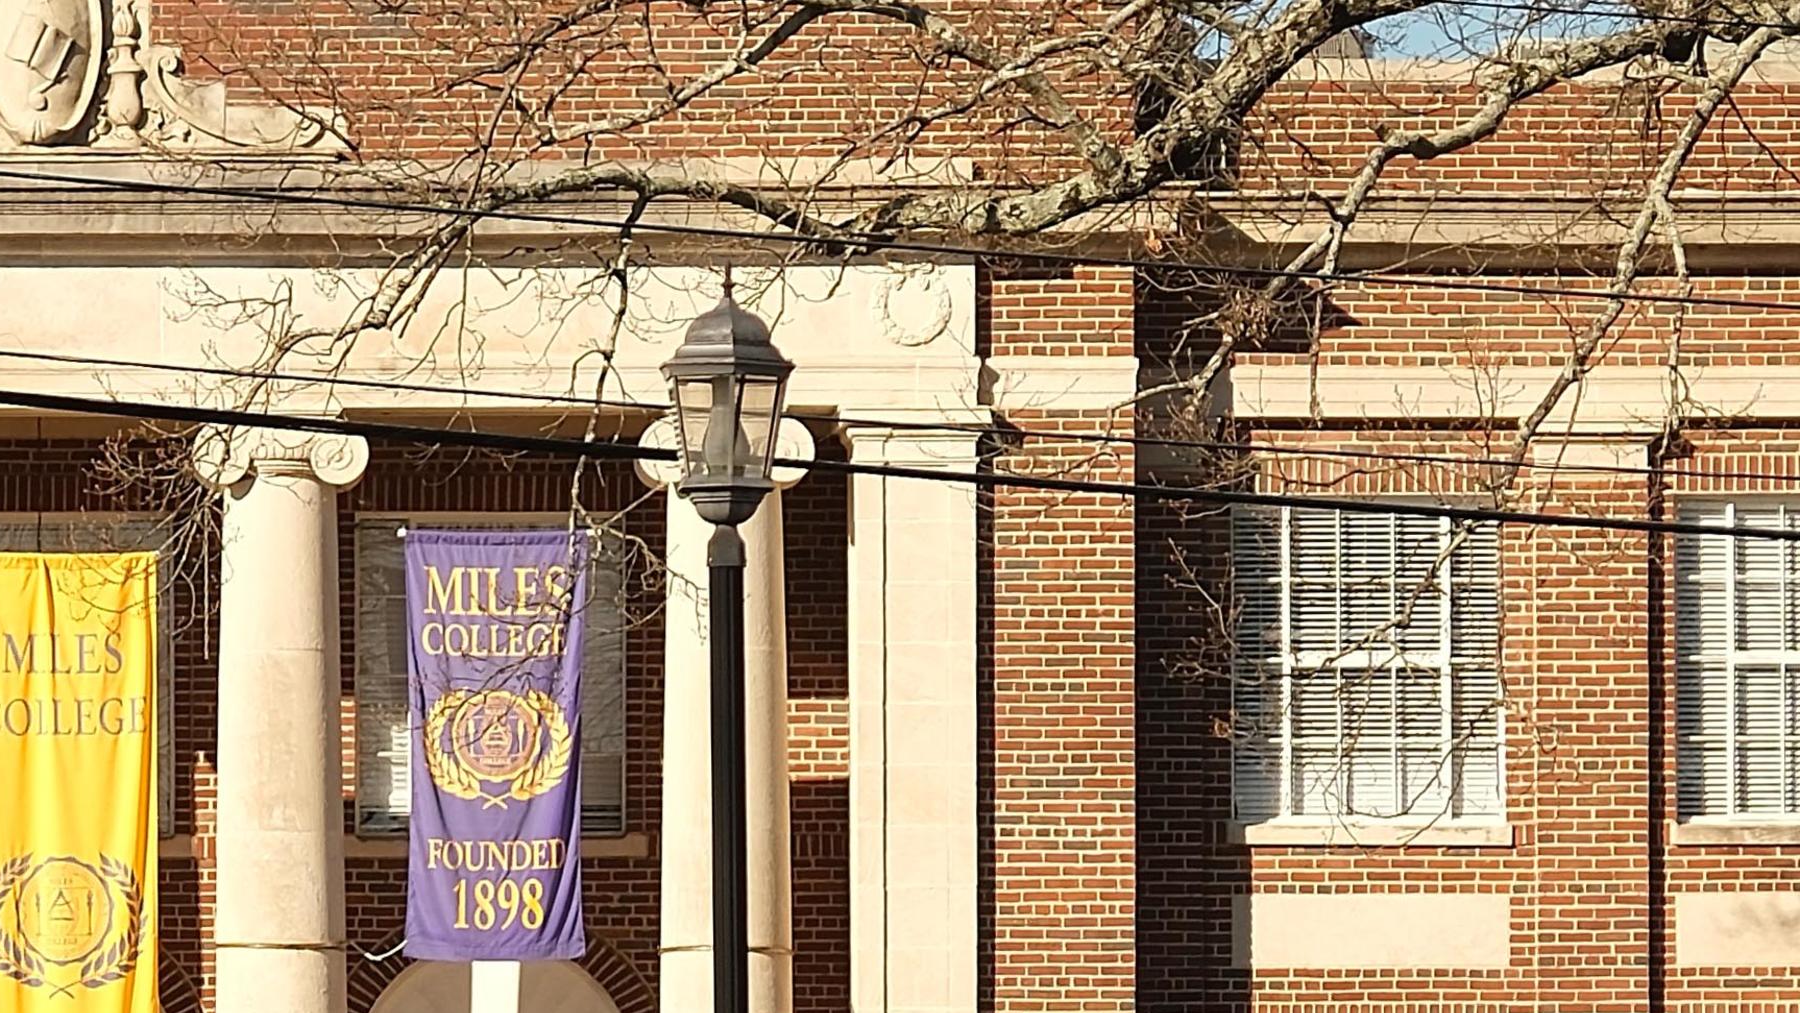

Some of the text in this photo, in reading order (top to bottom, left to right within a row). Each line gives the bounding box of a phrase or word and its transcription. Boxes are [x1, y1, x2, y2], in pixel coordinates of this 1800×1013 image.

[423, 565, 572, 616] MILES
[2, 632, 123, 675] MLES
[422, 622, 568, 657] COLLEGE
[427, 838, 566, 871] FOUNDED
[453, 878, 545, 931] 1898
